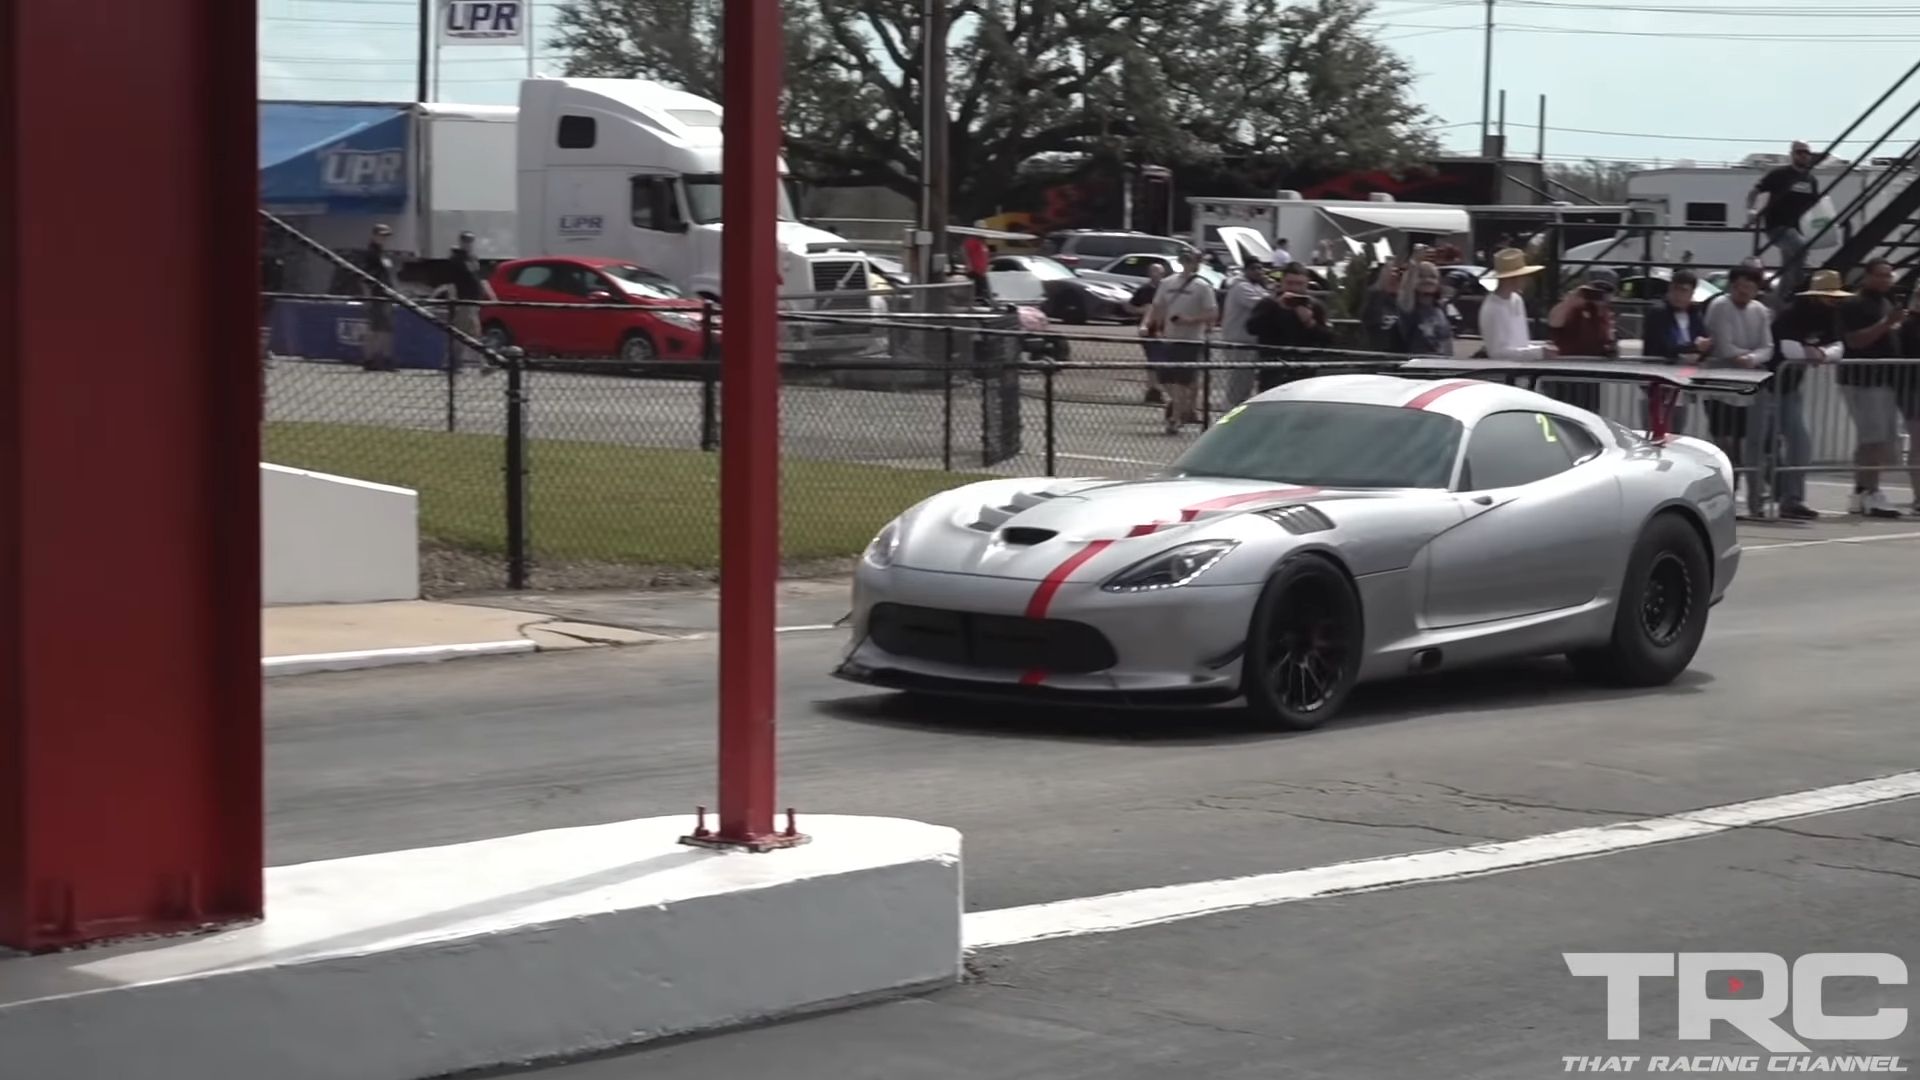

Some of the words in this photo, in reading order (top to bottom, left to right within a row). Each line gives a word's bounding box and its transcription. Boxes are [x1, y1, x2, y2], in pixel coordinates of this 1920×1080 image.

[448, 3, 517, 31] UPR
[326, 152, 402, 184] UPR
[1535, 413, 1557, 442] 2
